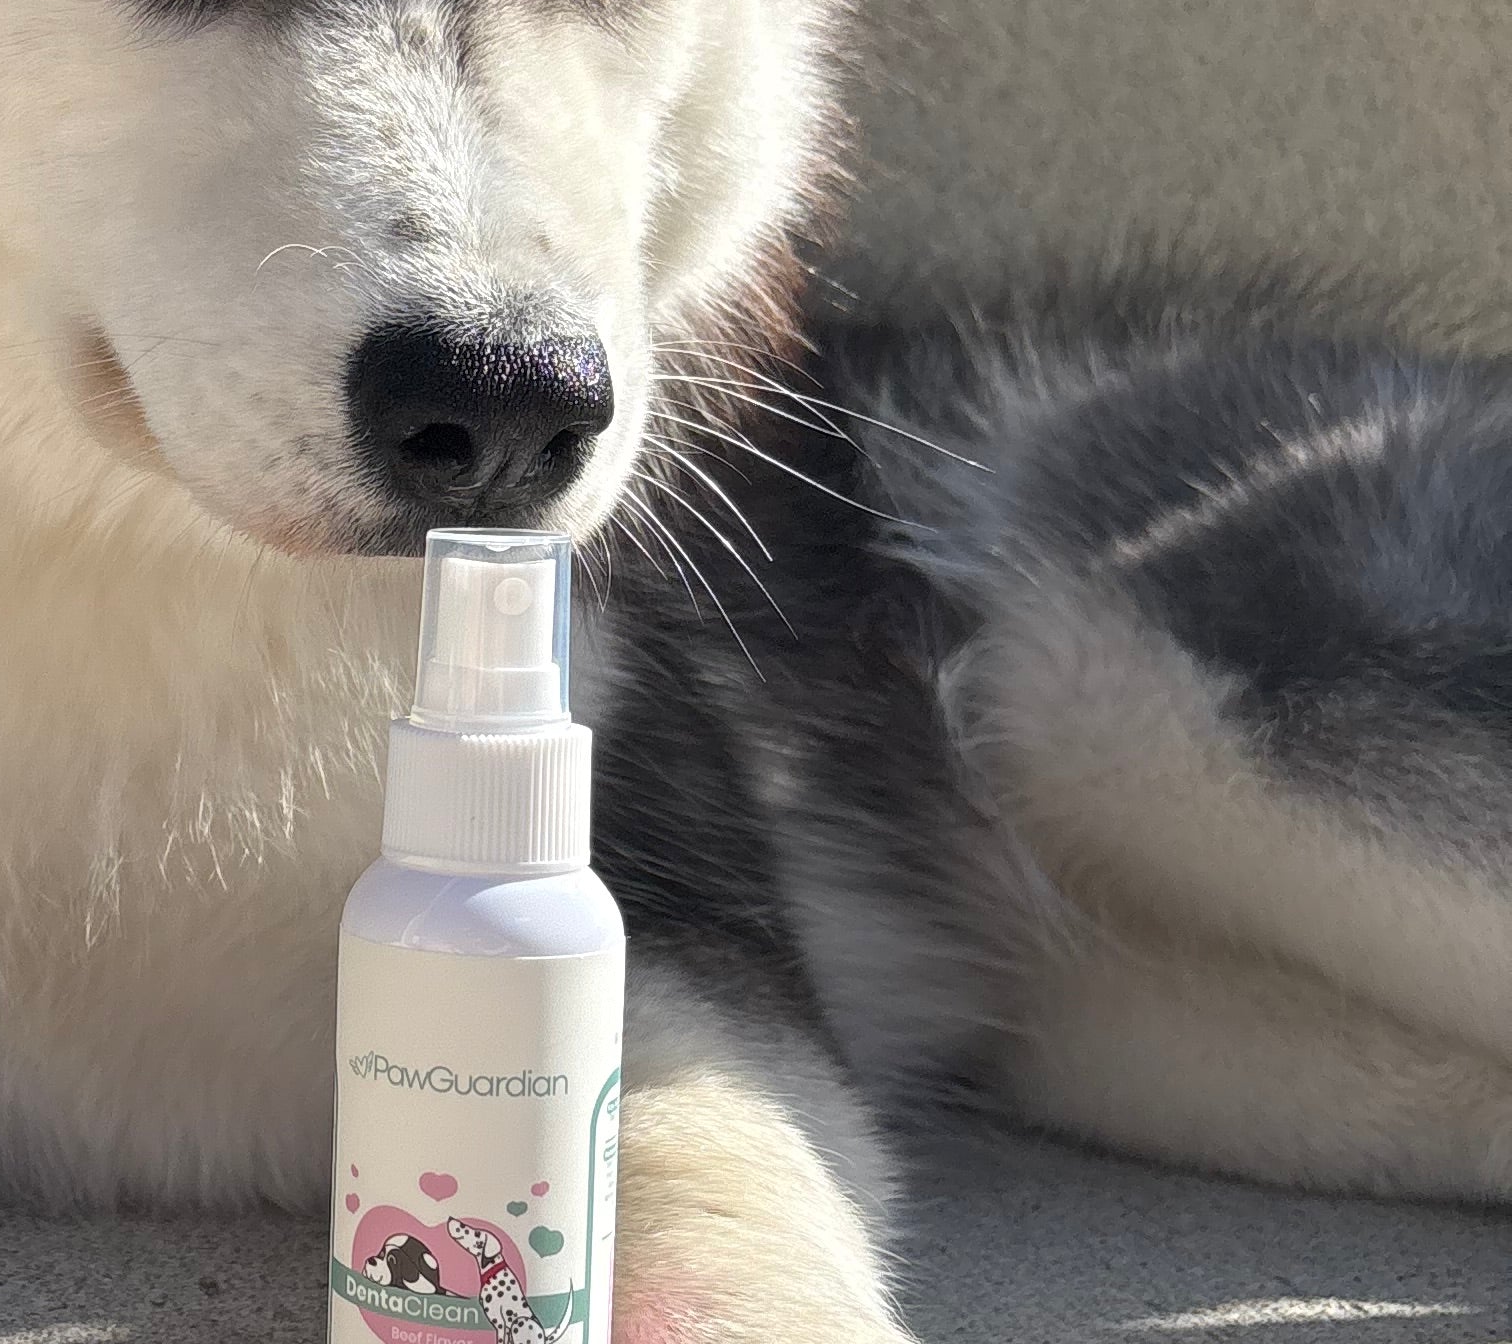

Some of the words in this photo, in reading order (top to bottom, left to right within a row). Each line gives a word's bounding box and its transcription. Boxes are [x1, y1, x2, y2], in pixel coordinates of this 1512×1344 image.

[373, 1054, 569, 1098] PawGuardian
[346, 1274, 479, 1324] DentaClean
[391, 1326, 423, 1344] Beef
